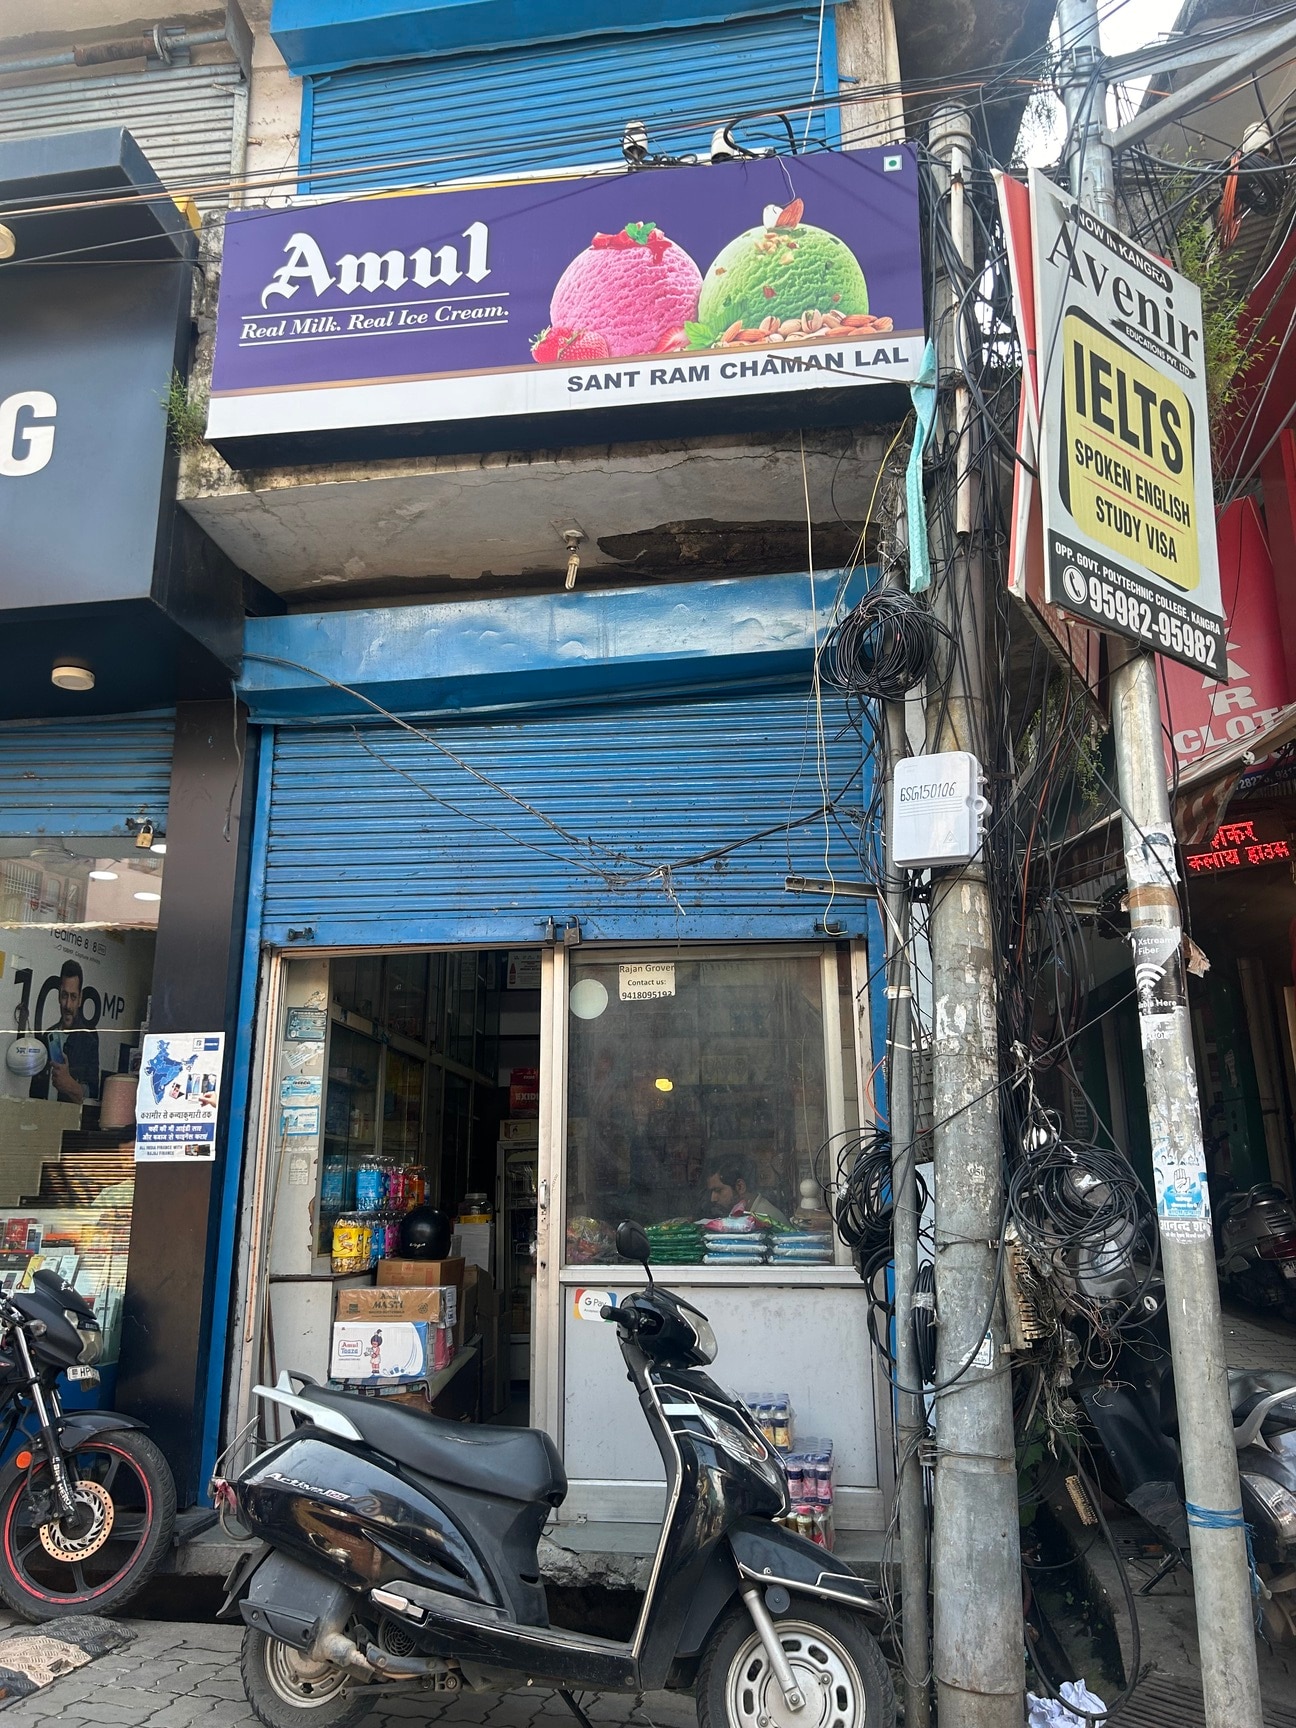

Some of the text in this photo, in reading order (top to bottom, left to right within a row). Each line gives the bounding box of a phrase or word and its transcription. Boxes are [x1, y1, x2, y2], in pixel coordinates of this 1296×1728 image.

[261, 221, 491, 309] Amul
[1078, 212, 1168, 288] NOW IN KANGRA
[1046, 220, 1199, 362] Avenir
[240, 303, 510, 340] Real Milk. Real Ice Cream.
[567, 346, 910, 393] SANT RAM CHAMAN LAL
[1125, 326, 1192, 378] EDUCATIONS PVT. LTD.
[1073, 339, 1184, 475] IELTS
[1074, 438, 1192, 528] SPOKEN ENGLISH
[1095, 495, 1178, 564] STUDY VISA
[1055, 541, 1221, 636] OPP. GOVT. POLYTECHNIC COLLEGE, KANGRA
[1088, 576, 1217, 669] 95982-95982
[1173, 704, 1294, 754] CLOT
[619, 964, 675, 975] Rajan Grover
[1138, 946, 1160, 956] Fiber
[102, 992, 125, 1021] MP
[627, 979, 655, 987] Contact
[515, 1092, 539, 1101] EXID
[584, 1297, 593, 1306] G
